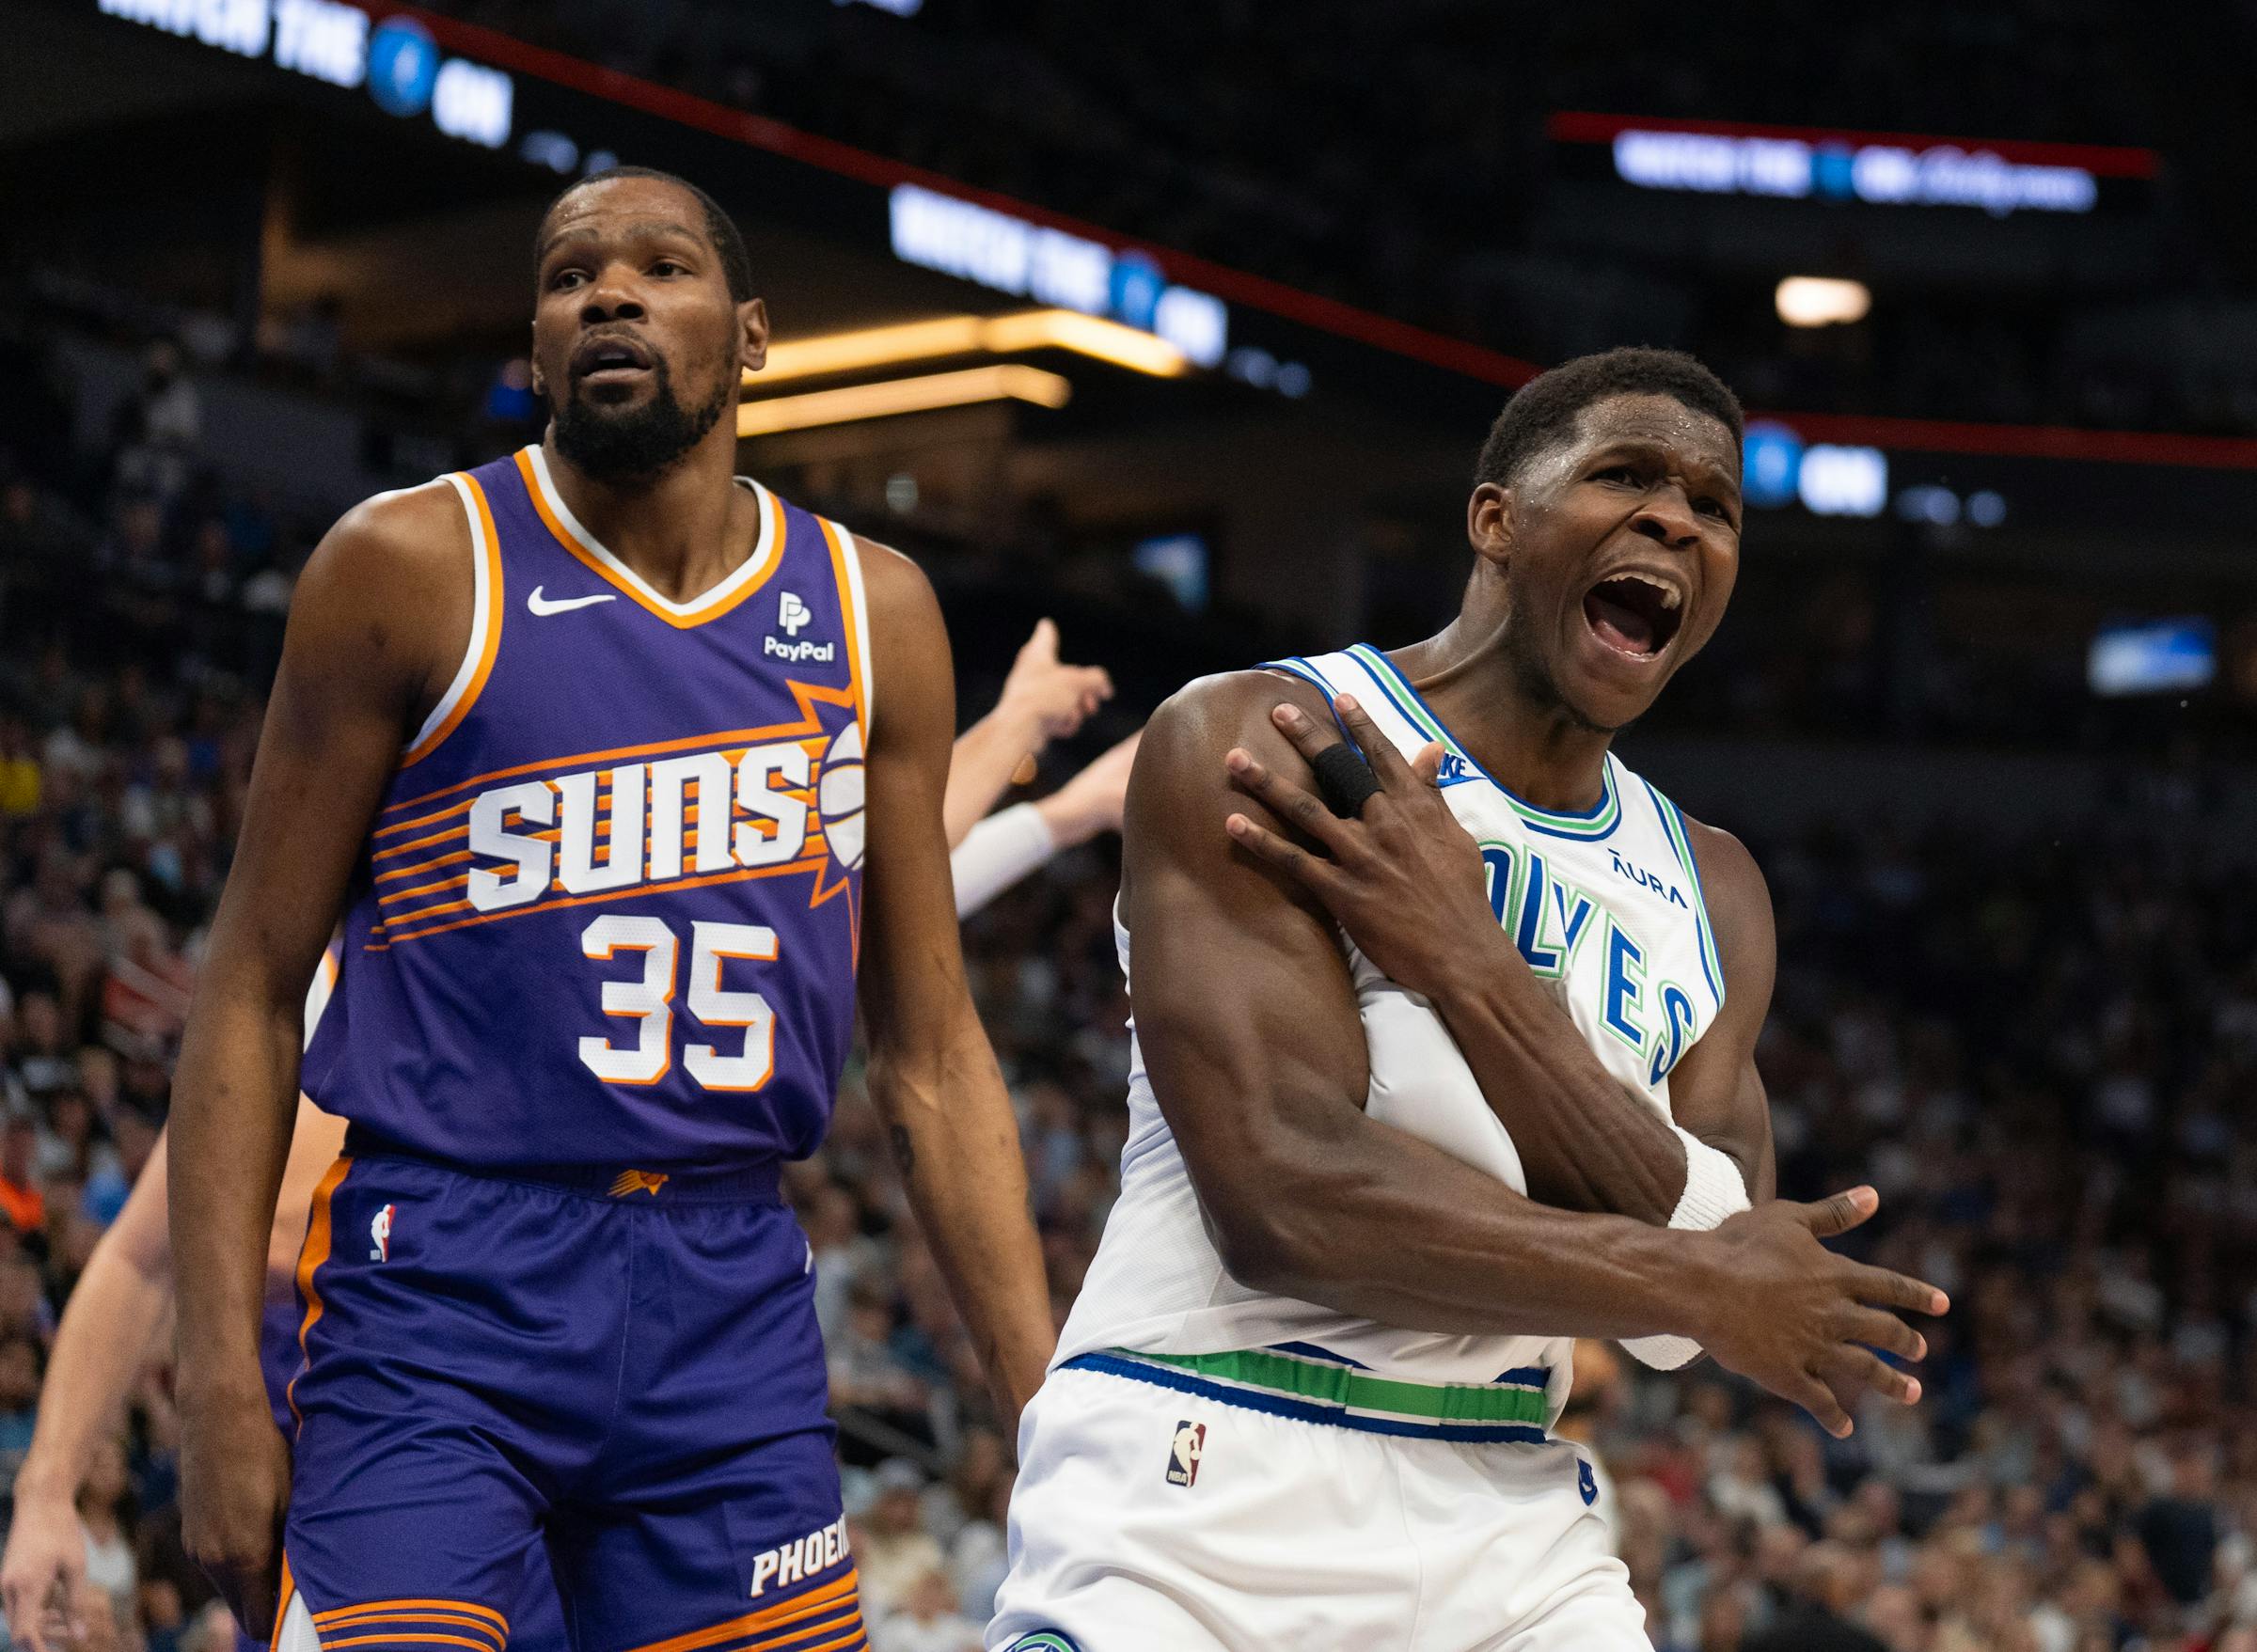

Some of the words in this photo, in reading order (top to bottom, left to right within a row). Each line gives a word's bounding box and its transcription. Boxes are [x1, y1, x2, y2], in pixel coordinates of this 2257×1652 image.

[764, 636, 835, 662] PayPal
[1439, 752, 1467, 779] KE
[1477, 841, 1698, 1091] OLVES
[578, 914, 780, 1093] 35
[1168, 1470, 1188, 1484] NBA
